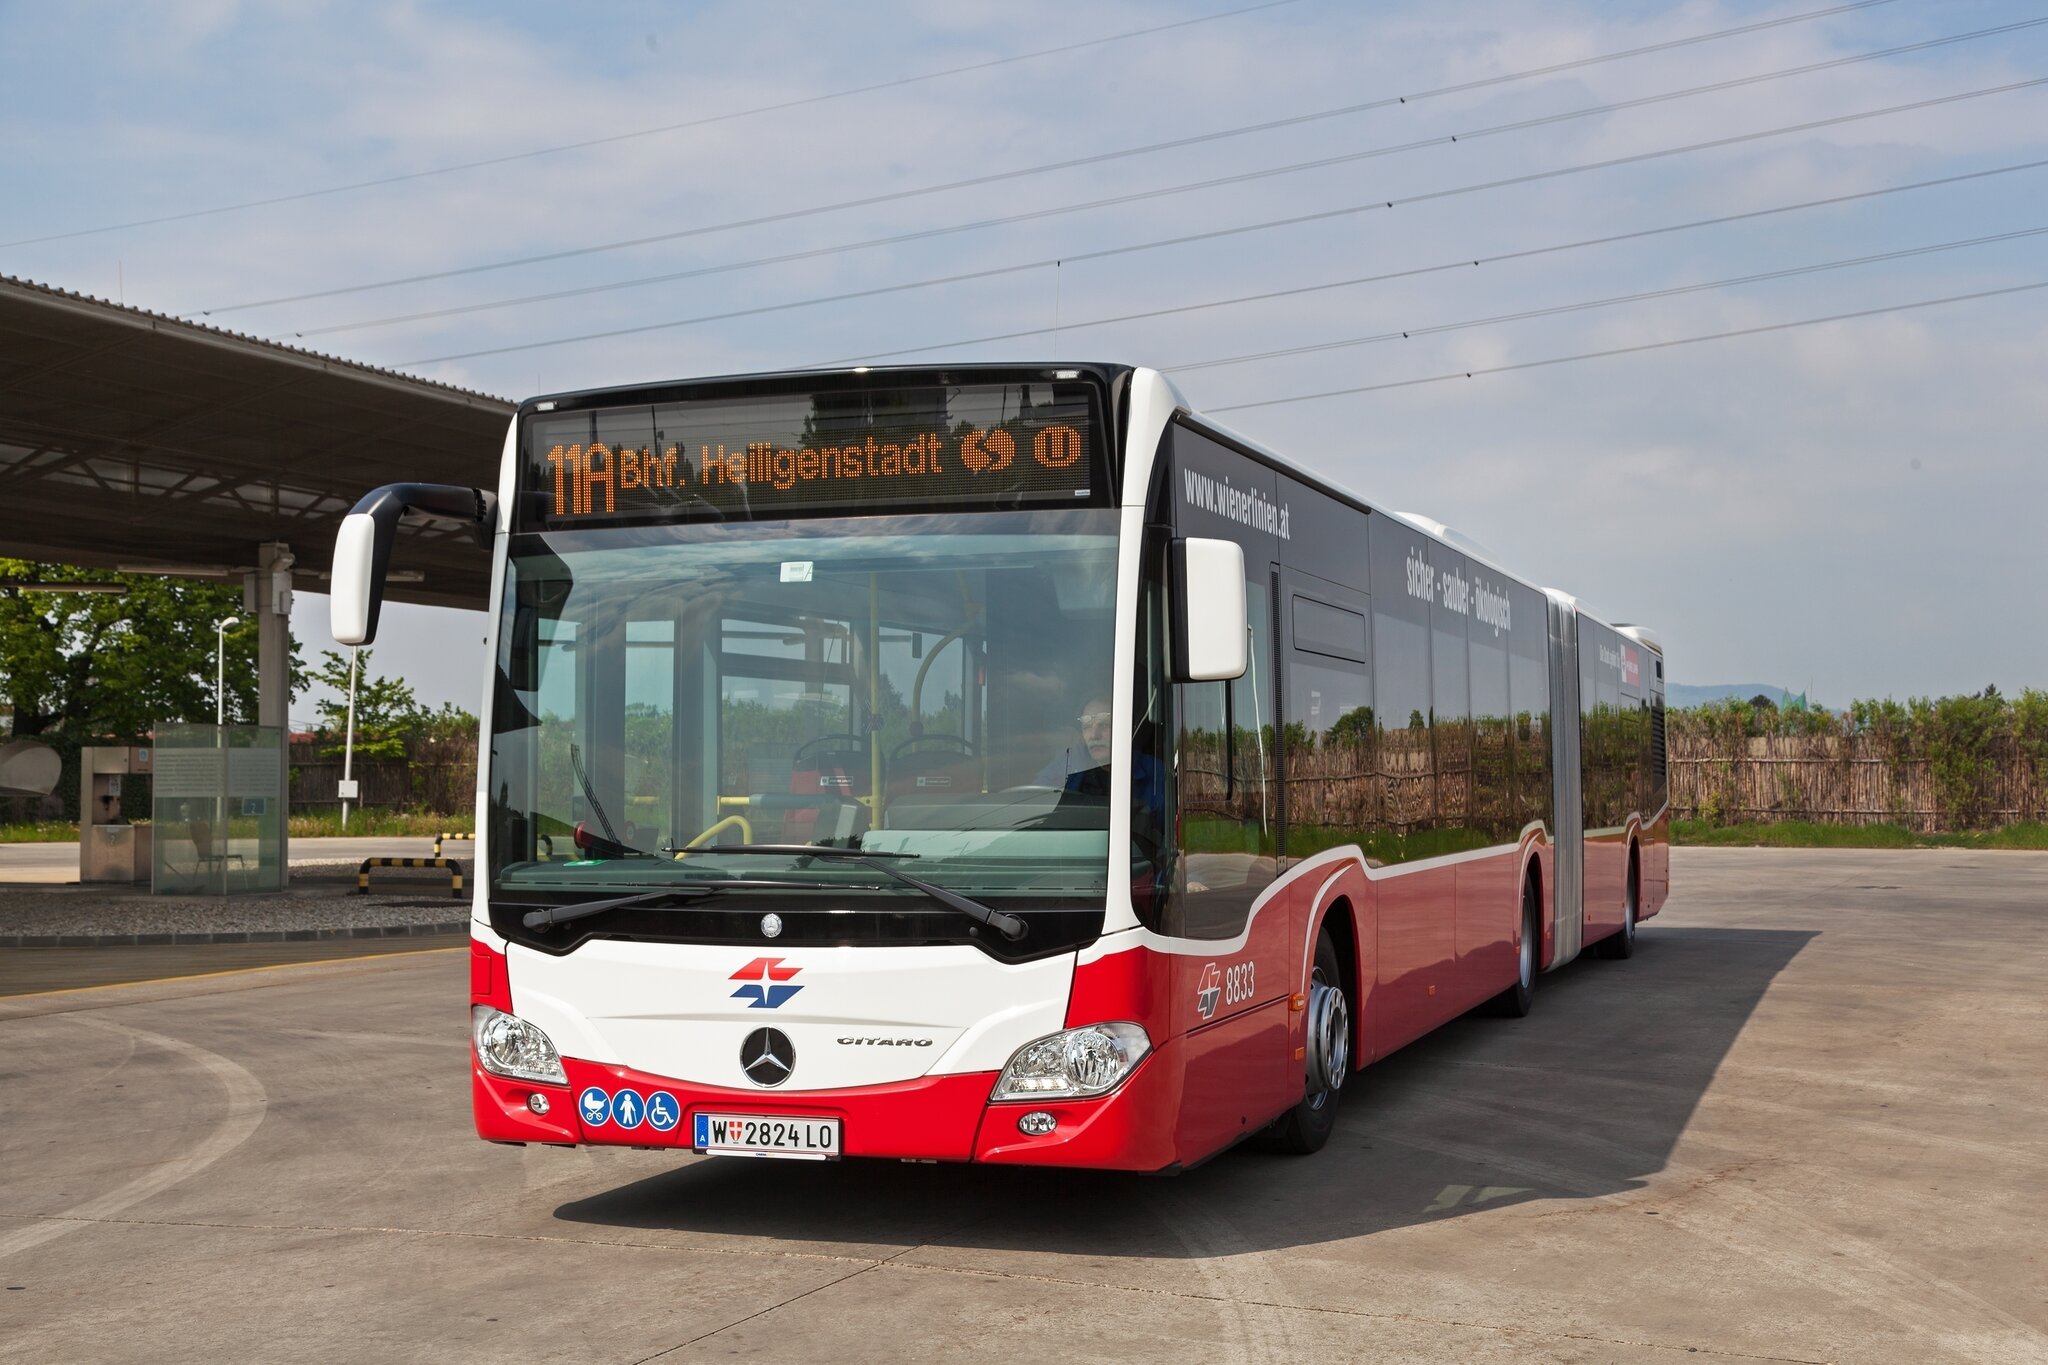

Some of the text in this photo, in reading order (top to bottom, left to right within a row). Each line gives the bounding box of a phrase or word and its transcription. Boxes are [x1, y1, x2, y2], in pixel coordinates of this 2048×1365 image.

[547, 443, 614, 515] 11A
[620, 447, 685, 489] Bhf.
[702, 433, 943, 490] Heiligenstadt
[1184, 468, 1290, 540] www.wienerlinien.at
[1406, 546, 1435, 603] sicher
[1442, 567, 1469, 616] sauber
[1475, 576, 1511, 638] ökologisch
[1226, 960, 1255, 1006] 8833
[836, 1037, 933, 1047] CITARO
[699, 1134, 706, 1142] A
[712, 1120, 832, 1149] W 2824 LO
